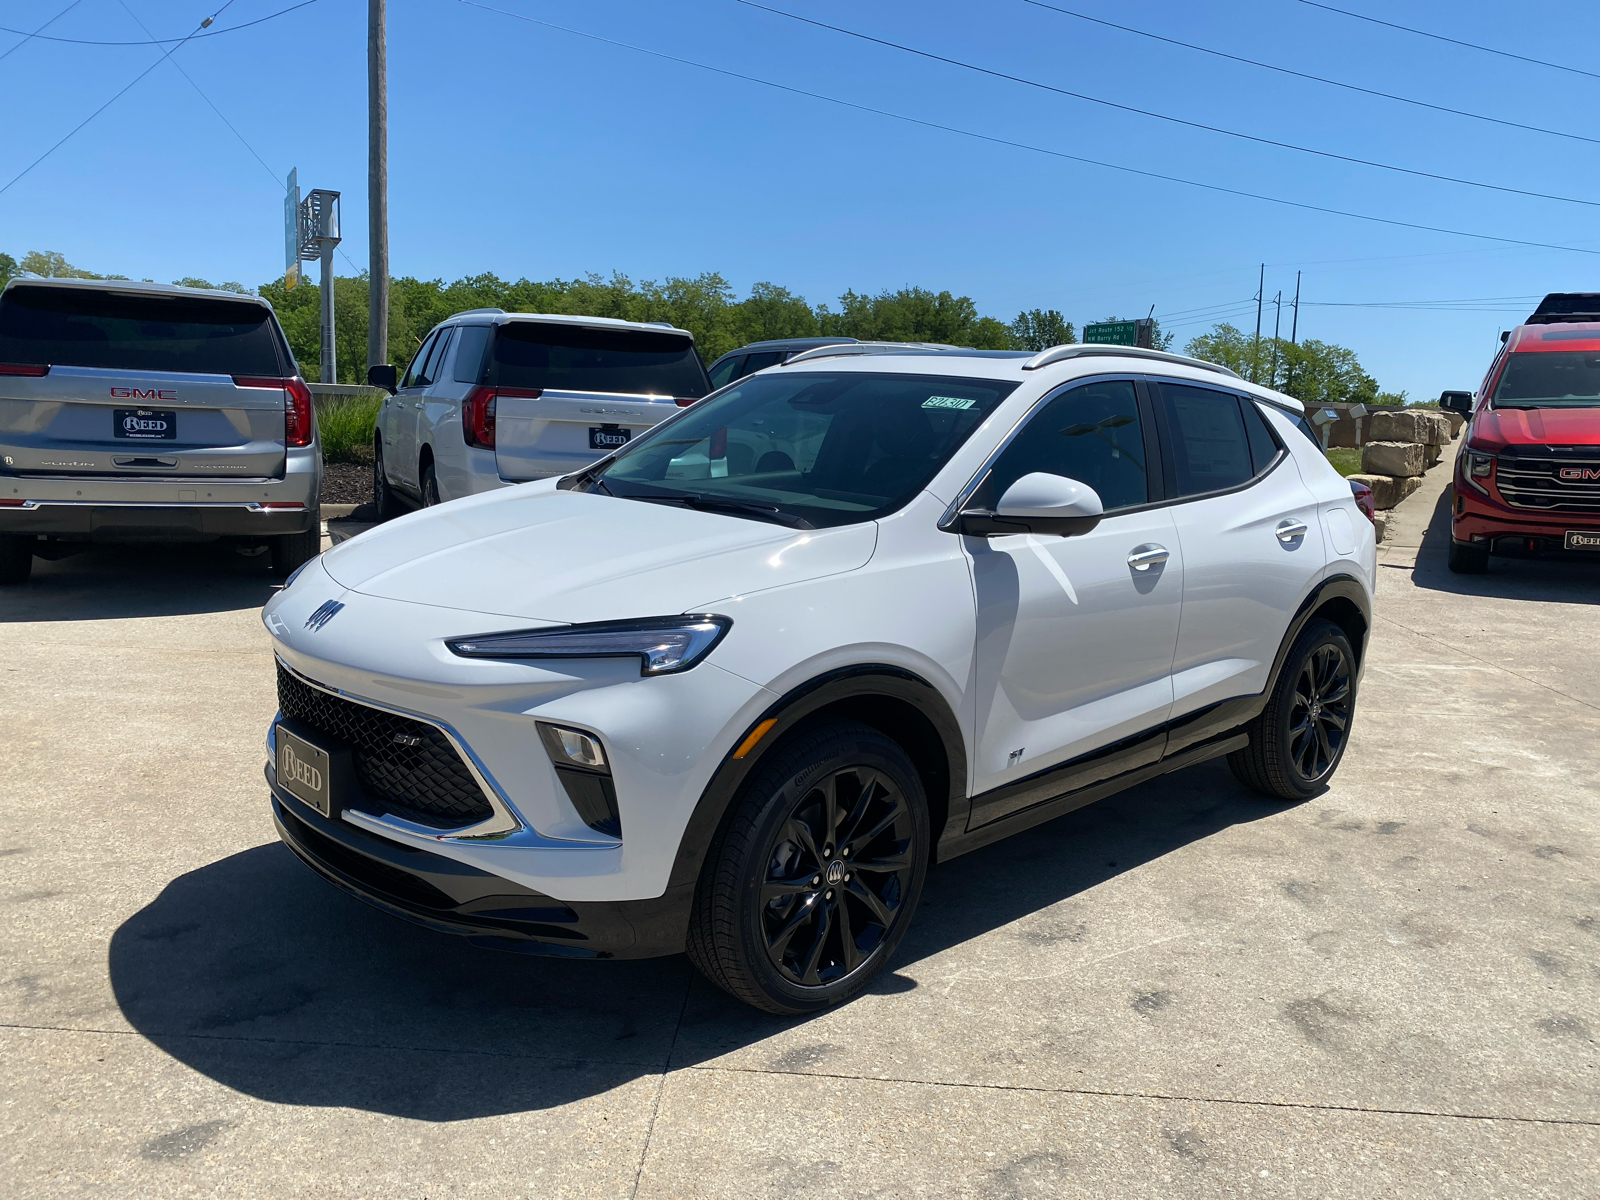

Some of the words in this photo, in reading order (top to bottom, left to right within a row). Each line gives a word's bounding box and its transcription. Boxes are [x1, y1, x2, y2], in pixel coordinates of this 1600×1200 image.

[110, 387, 178, 401] GMC
[123, 416, 168, 432] REED
[594, 432, 627, 446] REED
[393, 732, 421, 747] ST
[282, 744, 321, 792] REED
